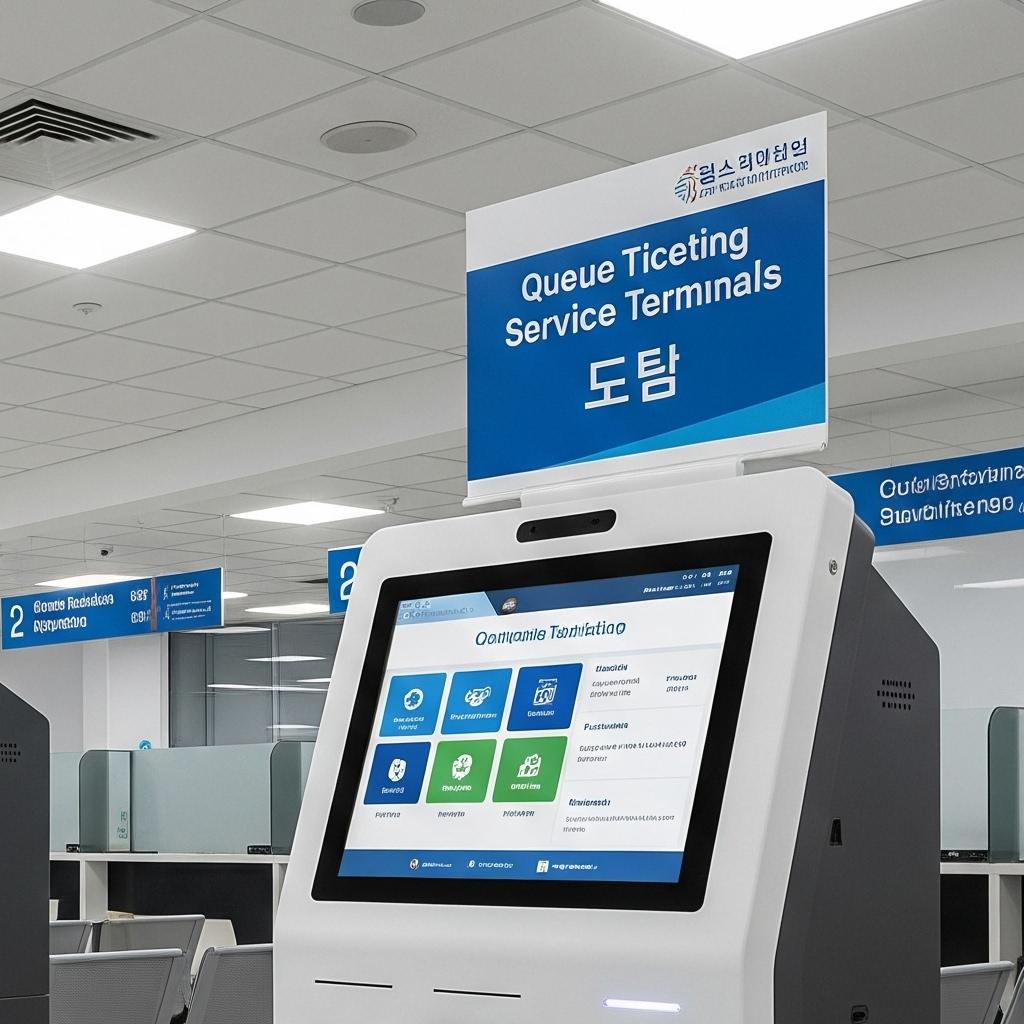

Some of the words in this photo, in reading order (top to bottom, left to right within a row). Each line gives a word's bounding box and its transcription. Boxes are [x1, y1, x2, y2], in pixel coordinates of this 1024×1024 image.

[521, 259, 615, 302] Queue
[622, 226, 749, 277] Ticeting
[505, 302, 617, 348] Service
[584, 343, 680, 410] 도탐
[340, 561, 358, 601] 2
[10, 604, 25, 639] 2
